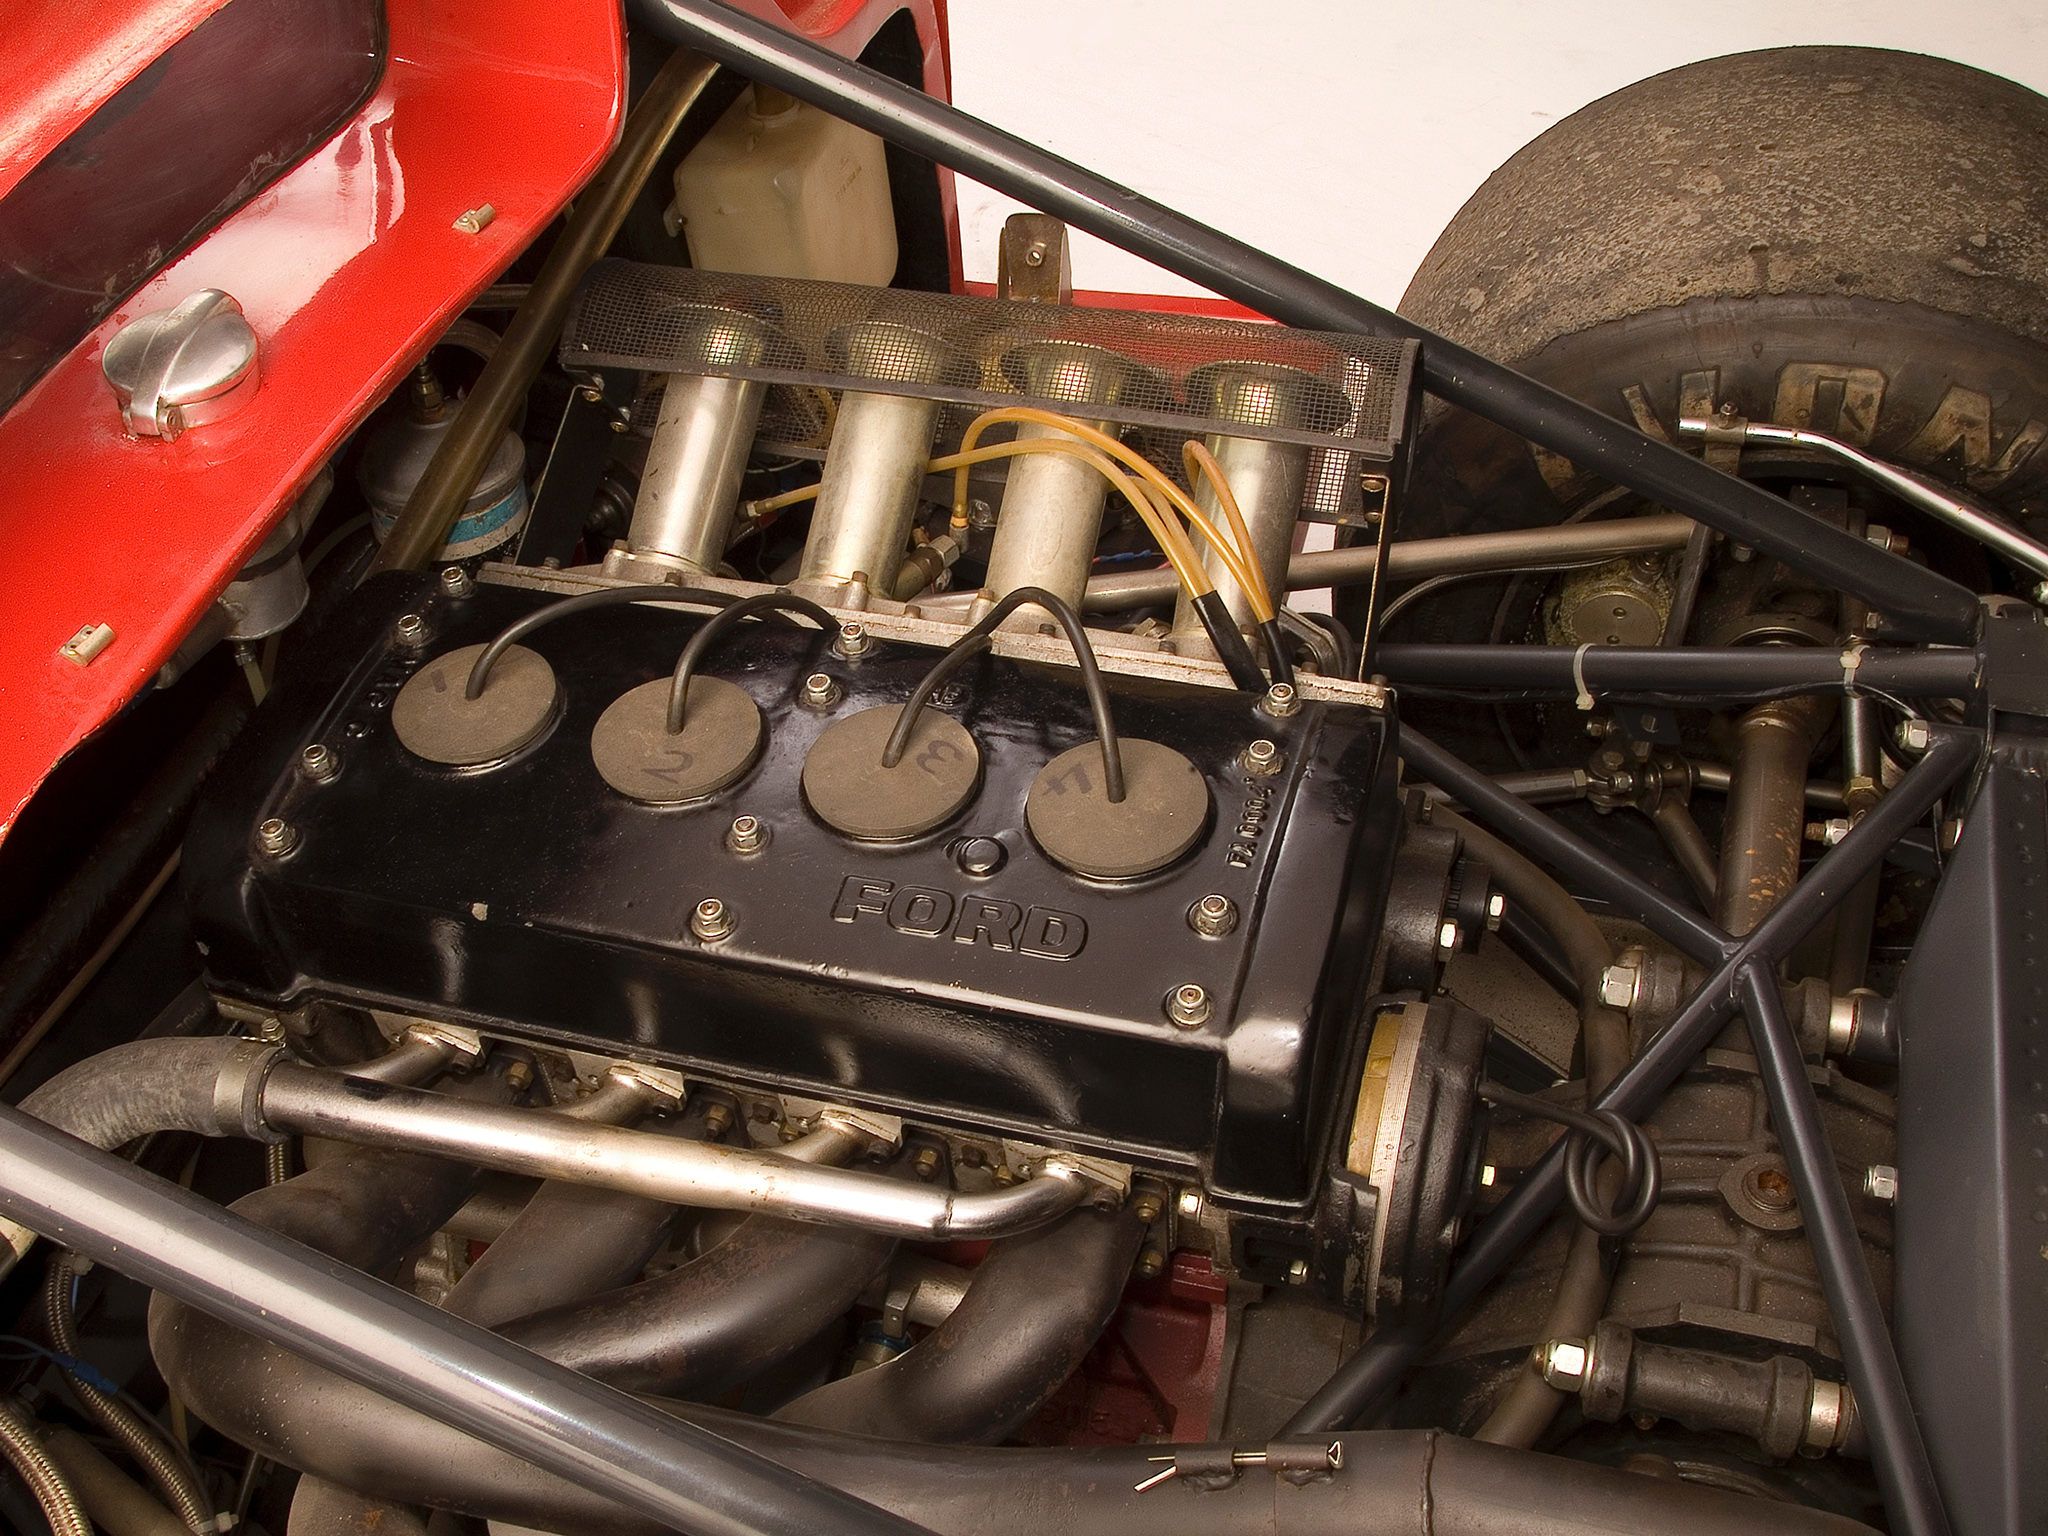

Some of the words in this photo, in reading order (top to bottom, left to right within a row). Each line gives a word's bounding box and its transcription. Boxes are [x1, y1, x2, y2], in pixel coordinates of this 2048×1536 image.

[640, 750, 694, 785] 2
[915, 738, 966, 776] 3
[1040, 761, 1094, 796] 4
[829, 874, 1090, 963] FORD
